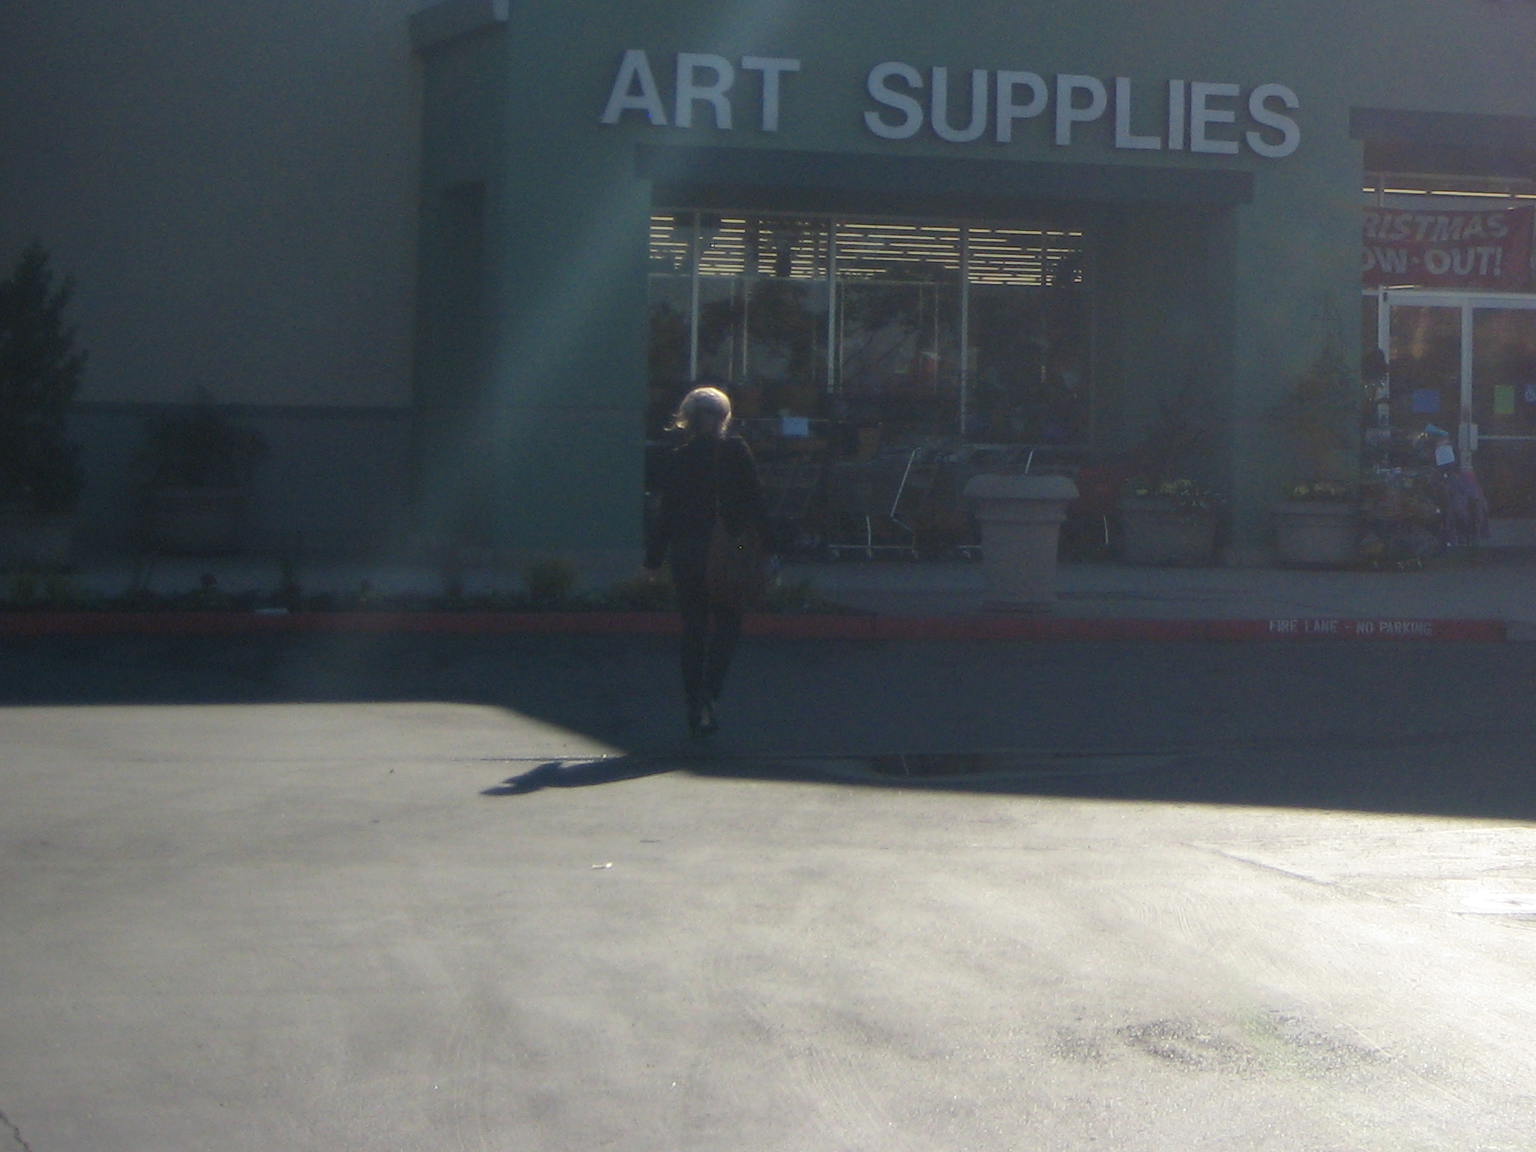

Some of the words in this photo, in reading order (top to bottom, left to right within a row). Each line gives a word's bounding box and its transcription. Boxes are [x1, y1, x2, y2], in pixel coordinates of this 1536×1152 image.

[601, 49, 800, 131] ART
[863, 61, 1301, 158] SUPPLIES
[1269, 619, 1298, 633] FIRE
[1304, 620, 1339, 633] LANE
[1356, 621, 1374, 634] NO
[1379, 621, 1433, 636] PARKING
